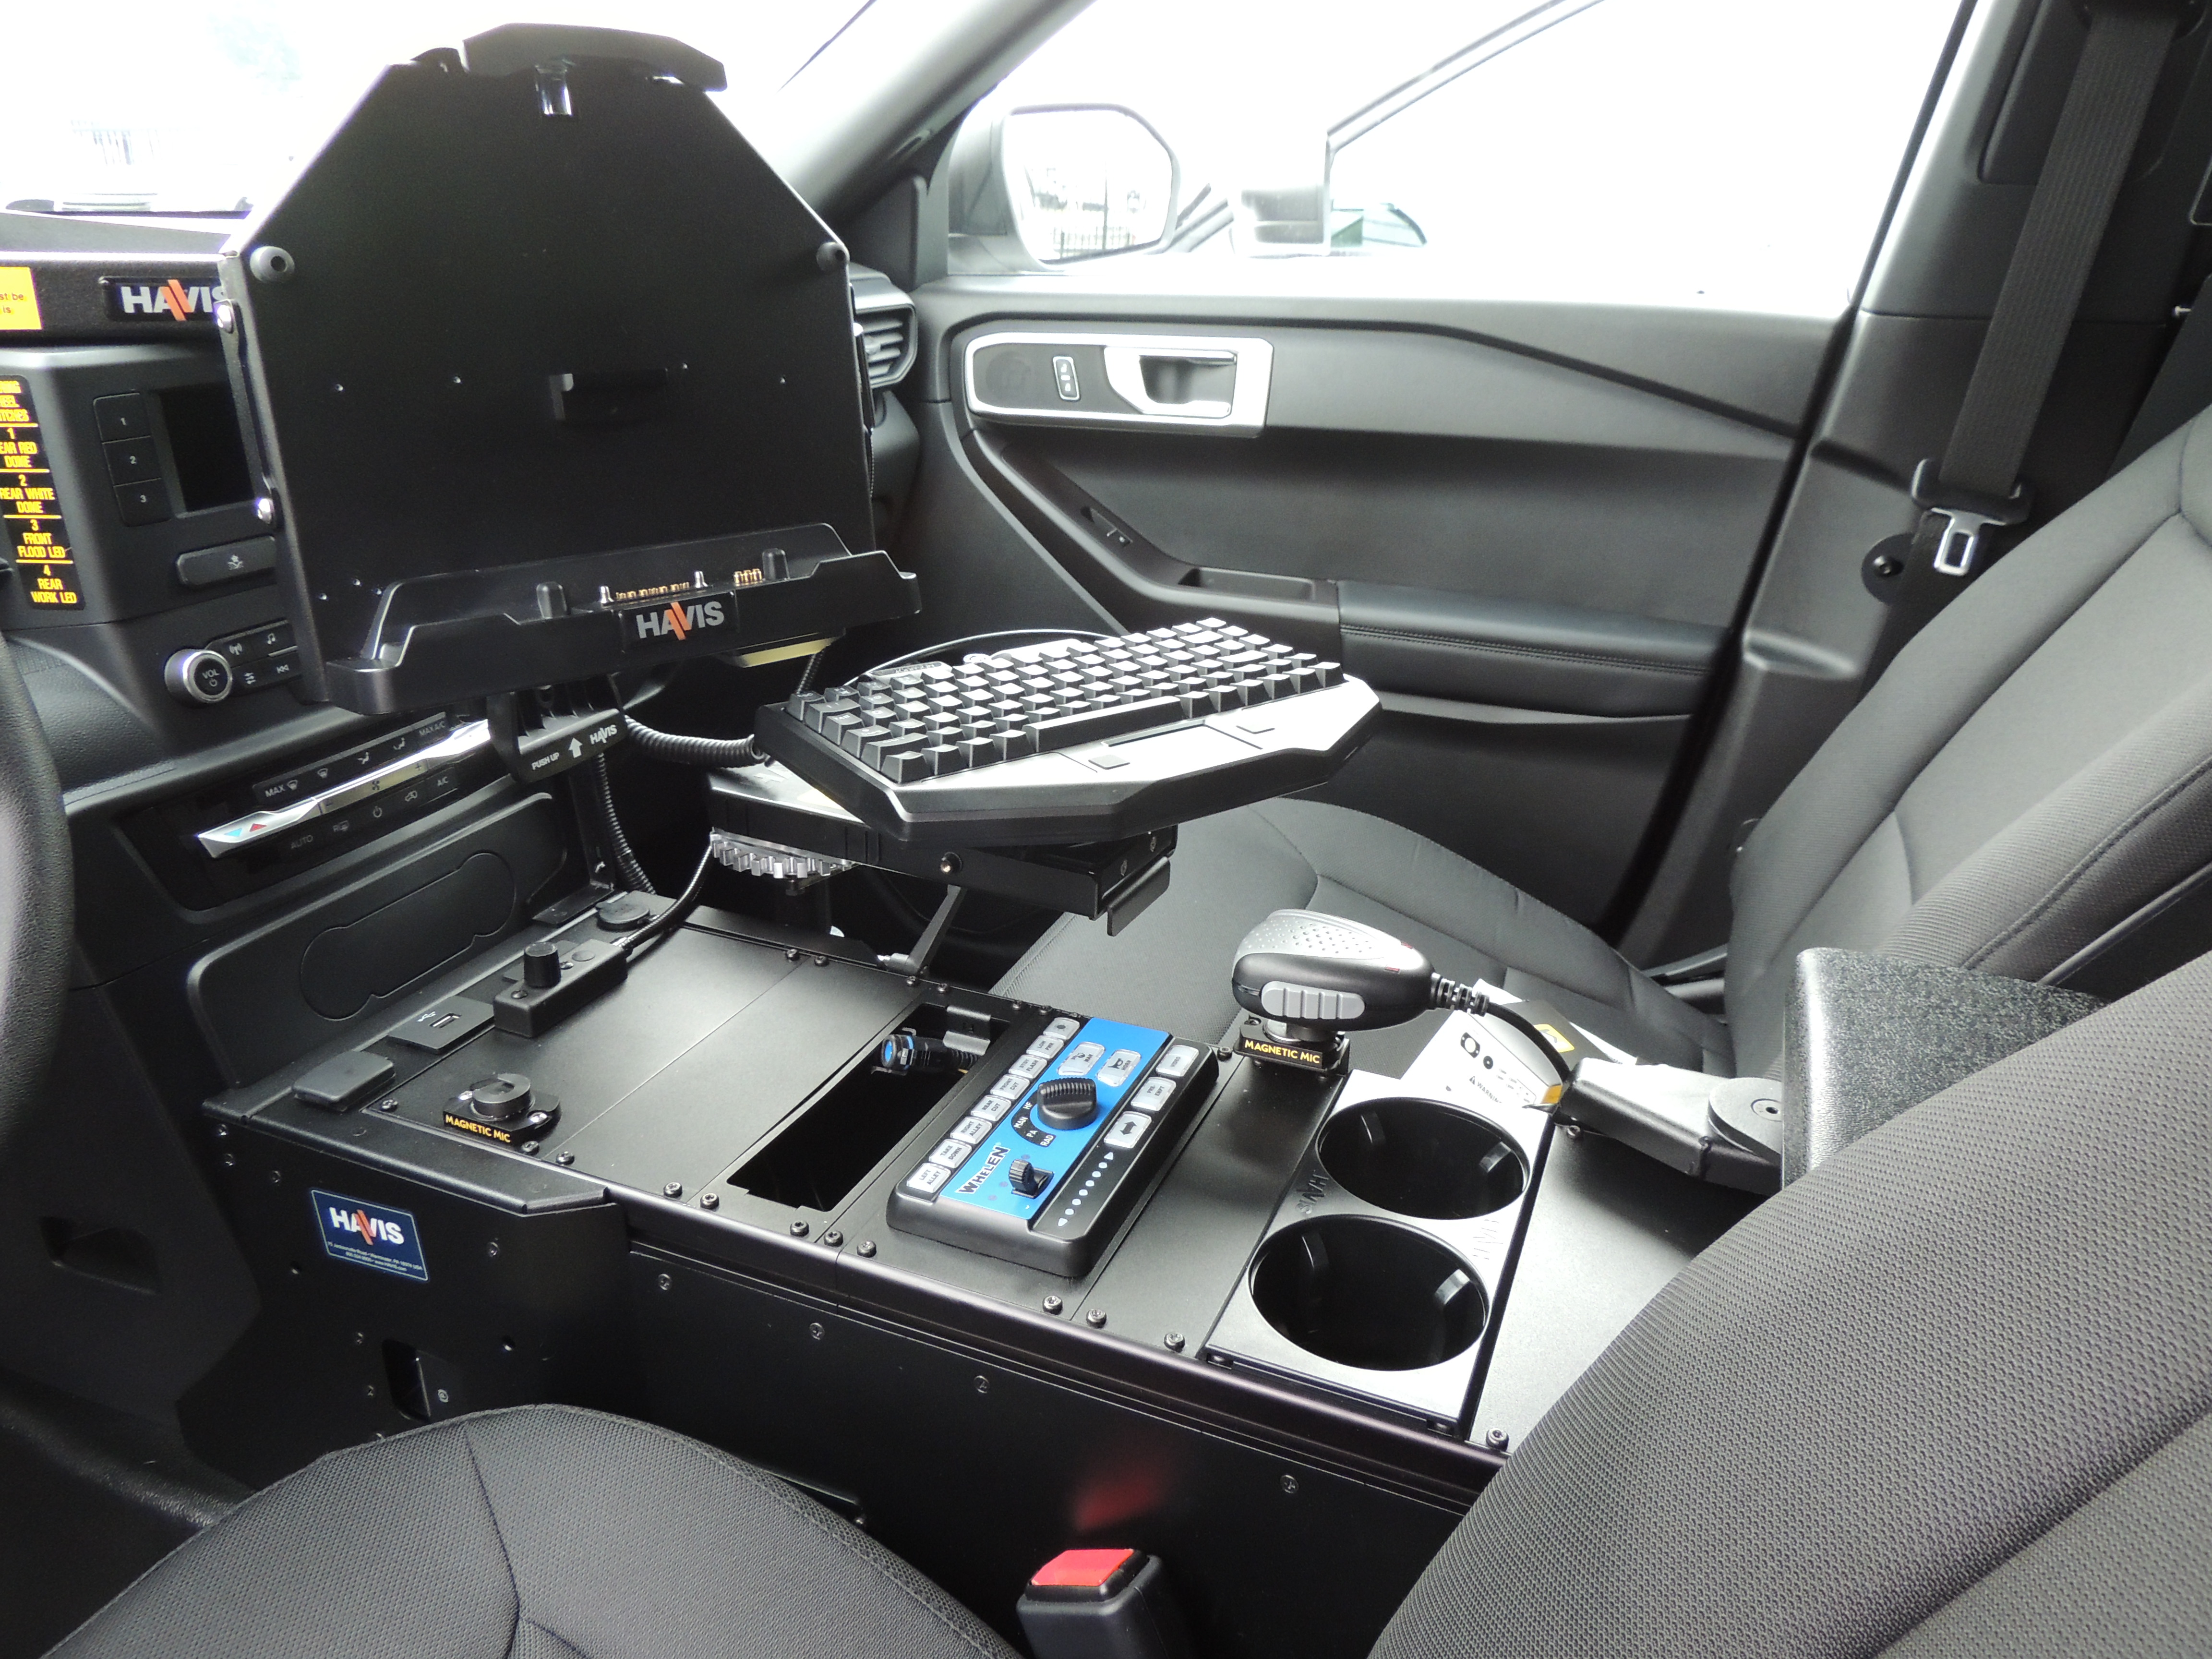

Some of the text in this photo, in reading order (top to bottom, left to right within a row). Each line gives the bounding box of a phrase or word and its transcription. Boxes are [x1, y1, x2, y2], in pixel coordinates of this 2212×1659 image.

[12, 292, 24, 301] be
[3, 305, 12, 313] is
[120, 417, 127, 425] 1
[7, 428, 15, 440] 1
[18, 442, 38, 454] RED
[4, 456, 32, 468] DOME
[130, 456, 137, 464] 2
[18, 474, 28, 486] 2
[0, 487, 56, 500] REAR WHITE
[140, 494, 147, 503] 3
[16, 501, 44, 514] DOME
[30, 519, 39, 531] 3
[23, 532, 52, 545] FRONT
[17, 546, 66, 558] FLOOD LED
[43, 565, 51, 576] 4
[37, 578, 64, 590] REAR
[30, 591, 77, 604] WORK LED
[636, 601, 724, 640] HAVIS
[202, 669, 220, 679] VOL
[419, 721, 446, 736] MAX A/C
[589, 724, 617, 744] HAVIS
[531, 752, 560, 770] PUSH UP
[437, 776, 448, 787] A/C
[265, 784, 286, 797] MAX
[291, 834, 313, 849] AUTO
[1037, 1040, 1046, 1048] LOW
[1045, 1042, 1055, 1051] PWR
[1244, 1039, 1320, 1064] MAGNETIC MIC
[1083, 1054, 1094, 1062] MAN
[1170, 1056, 1181, 1067] VIDEO
[1026, 1059, 1039, 1071] FLASH
[1121, 1059, 1132, 1071] HORN
[999, 1078, 1013, 1090] FRONT
[1010, 1082, 1019, 1090] CUT
[1154, 1086, 1165, 1096] EMPT
[981, 1100, 994, 1110] REAR
[991, 1103, 1001, 1112] CUT
[1022, 1101, 1033, 1110] HF
[445, 1114, 511, 1143] MAGNETIC MIC
[960, 1121, 974, 1133] RIGHT
[1013, 1116, 1029, 1129] MAN
[969, 1122, 983, 1137] ALLEY
[1026, 1130, 1038, 1138] PA
[1040, 1134, 1054, 1147] RAD
[940, 1145, 953, 1156] TAKE
[948, 1147, 962, 1160] DOWN
[919, 1169, 931, 1180] LEFT
[957, 1146, 1010, 1193] WHELEN
[926, 1170, 941, 1185] ALLEY
[1296, 1174, 1329, 1214] HAVIS
[329, 1206, 405, 1246] HAVIS
